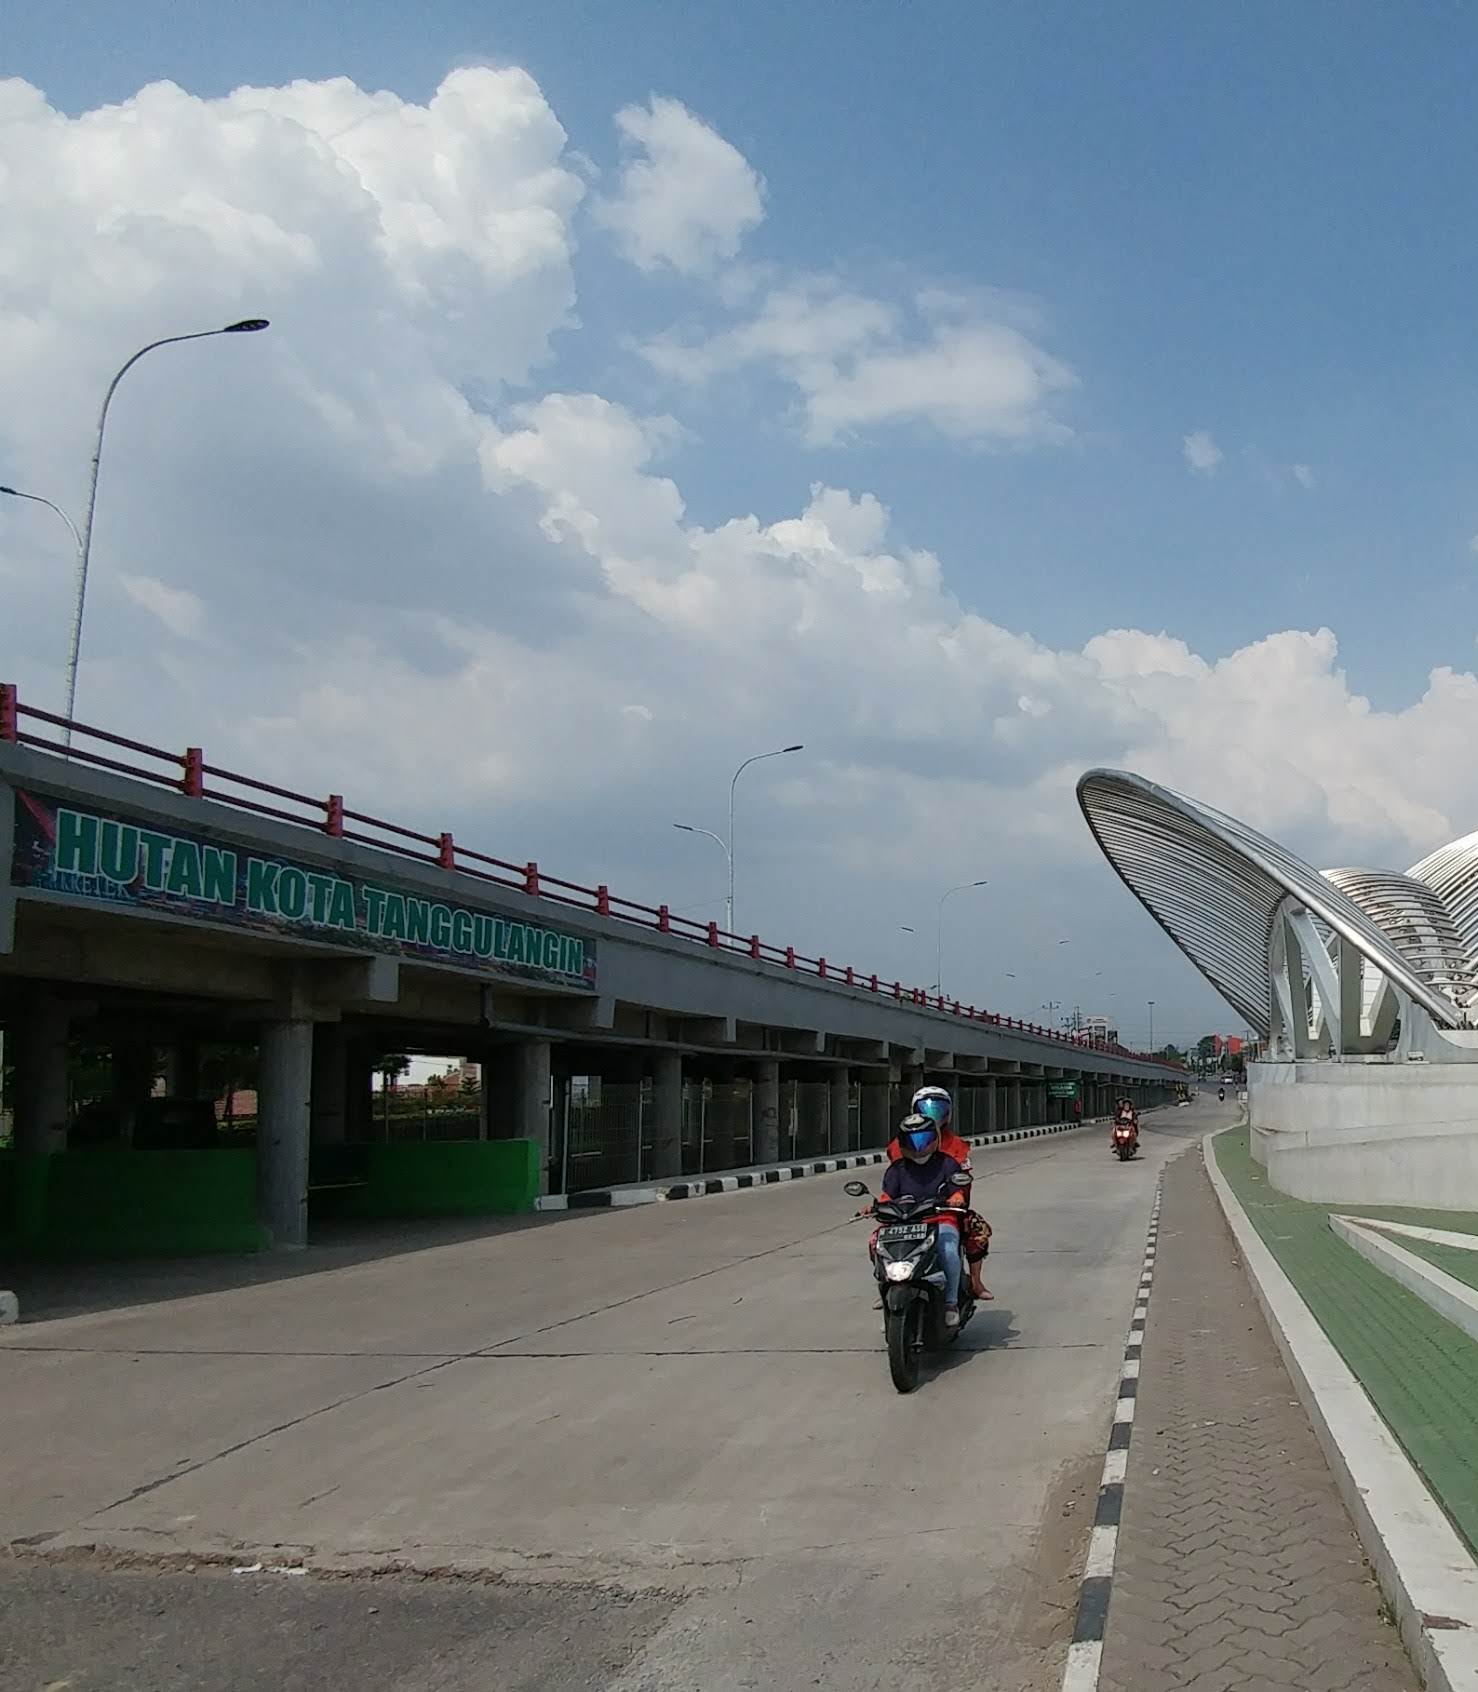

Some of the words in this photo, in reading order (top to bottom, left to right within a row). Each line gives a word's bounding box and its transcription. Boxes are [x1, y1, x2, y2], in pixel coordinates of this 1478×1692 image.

[56, 808, 237, 907] HUTAN
[247, 857, 356, 931] KOTA
[362, 884, 585, 977] TANGGULANGIN
